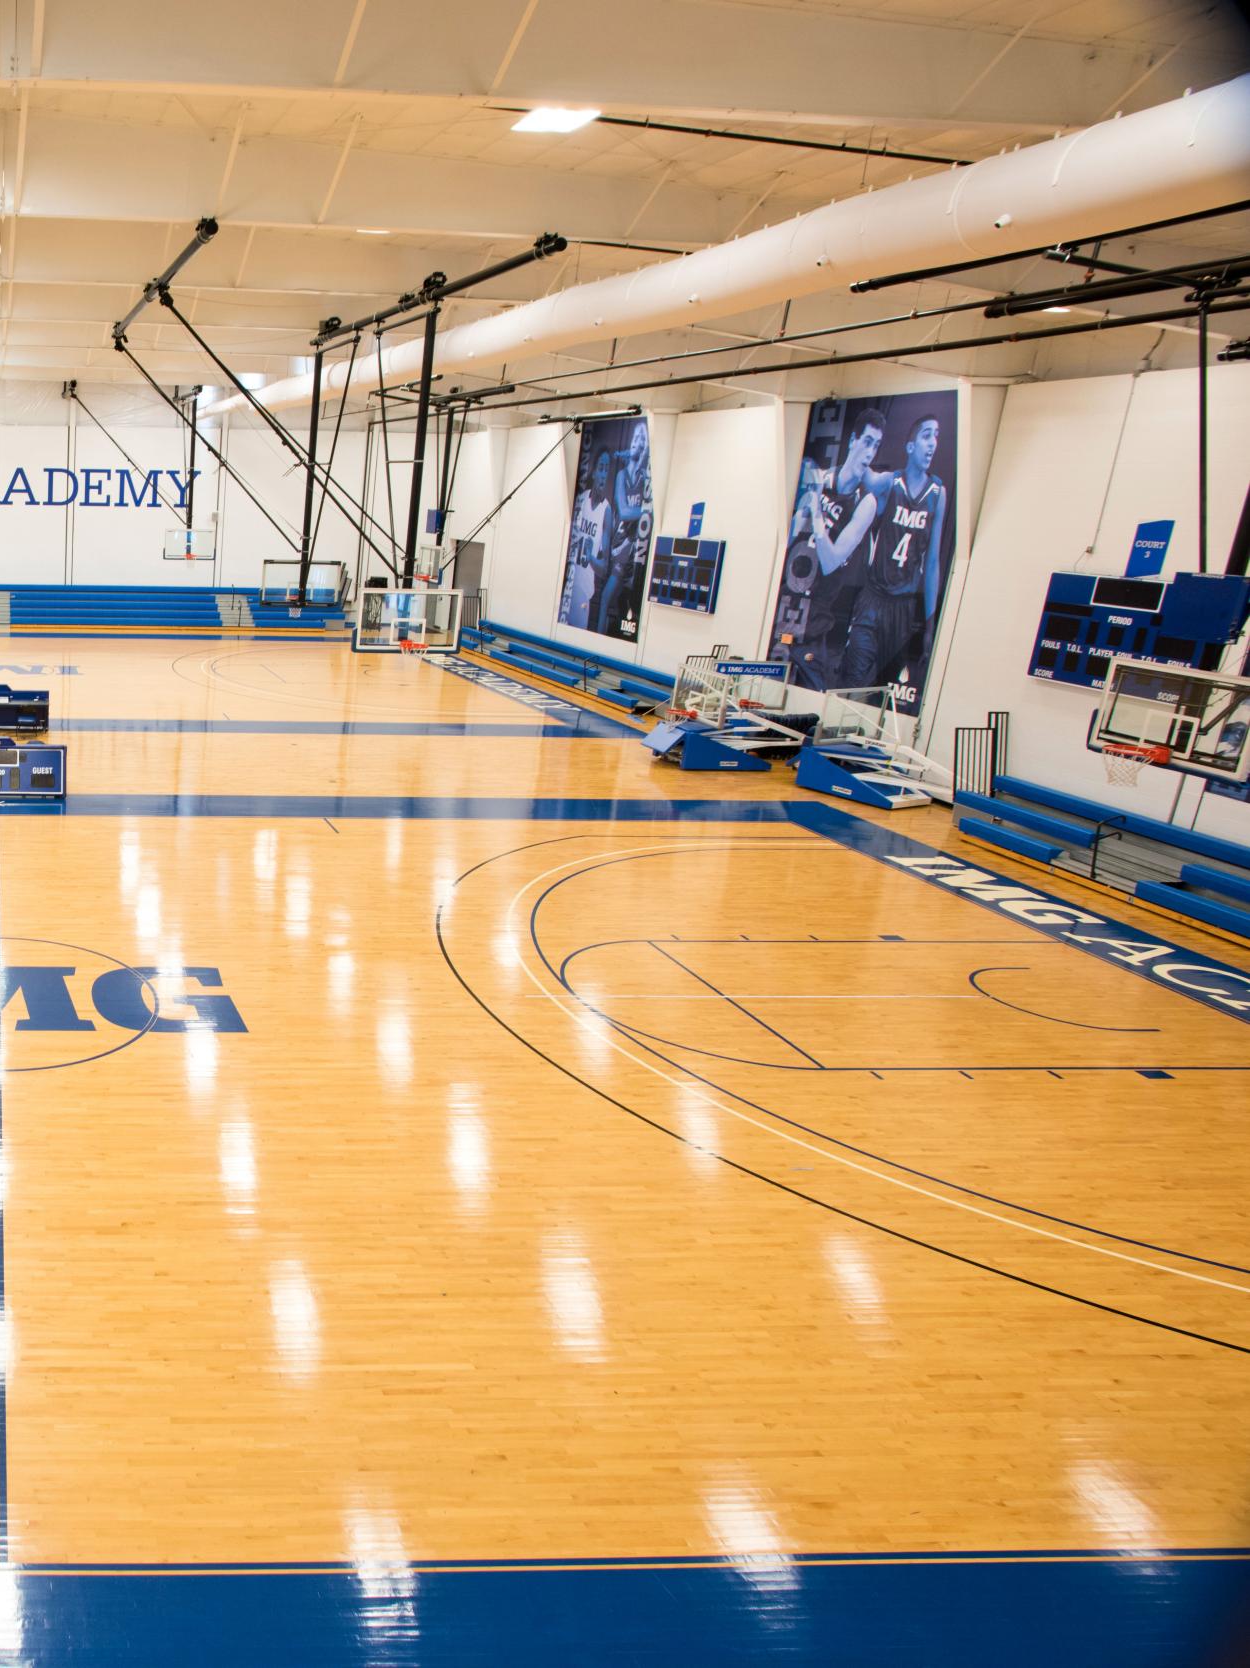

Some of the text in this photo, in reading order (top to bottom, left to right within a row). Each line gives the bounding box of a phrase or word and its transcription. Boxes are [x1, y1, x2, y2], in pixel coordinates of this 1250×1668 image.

[893, 505, 928, 529] IMG
[580, 518, 597, 537] IMG
[1135, 540, 1166, 549] COURT
[893, 533, 913, 568] 4
[1107, 615, 1133, 626] PERIOD
[621, 620, 636, 634] IMG
[1040, 640, 1061, 650] FOULS
[744, 666, 780, 675] ACADEMY
[1034, 668, 1054, 679] SCORE
[32, 767, 53, 775] GUEST
[884, 855, 1108, 925] IMG
